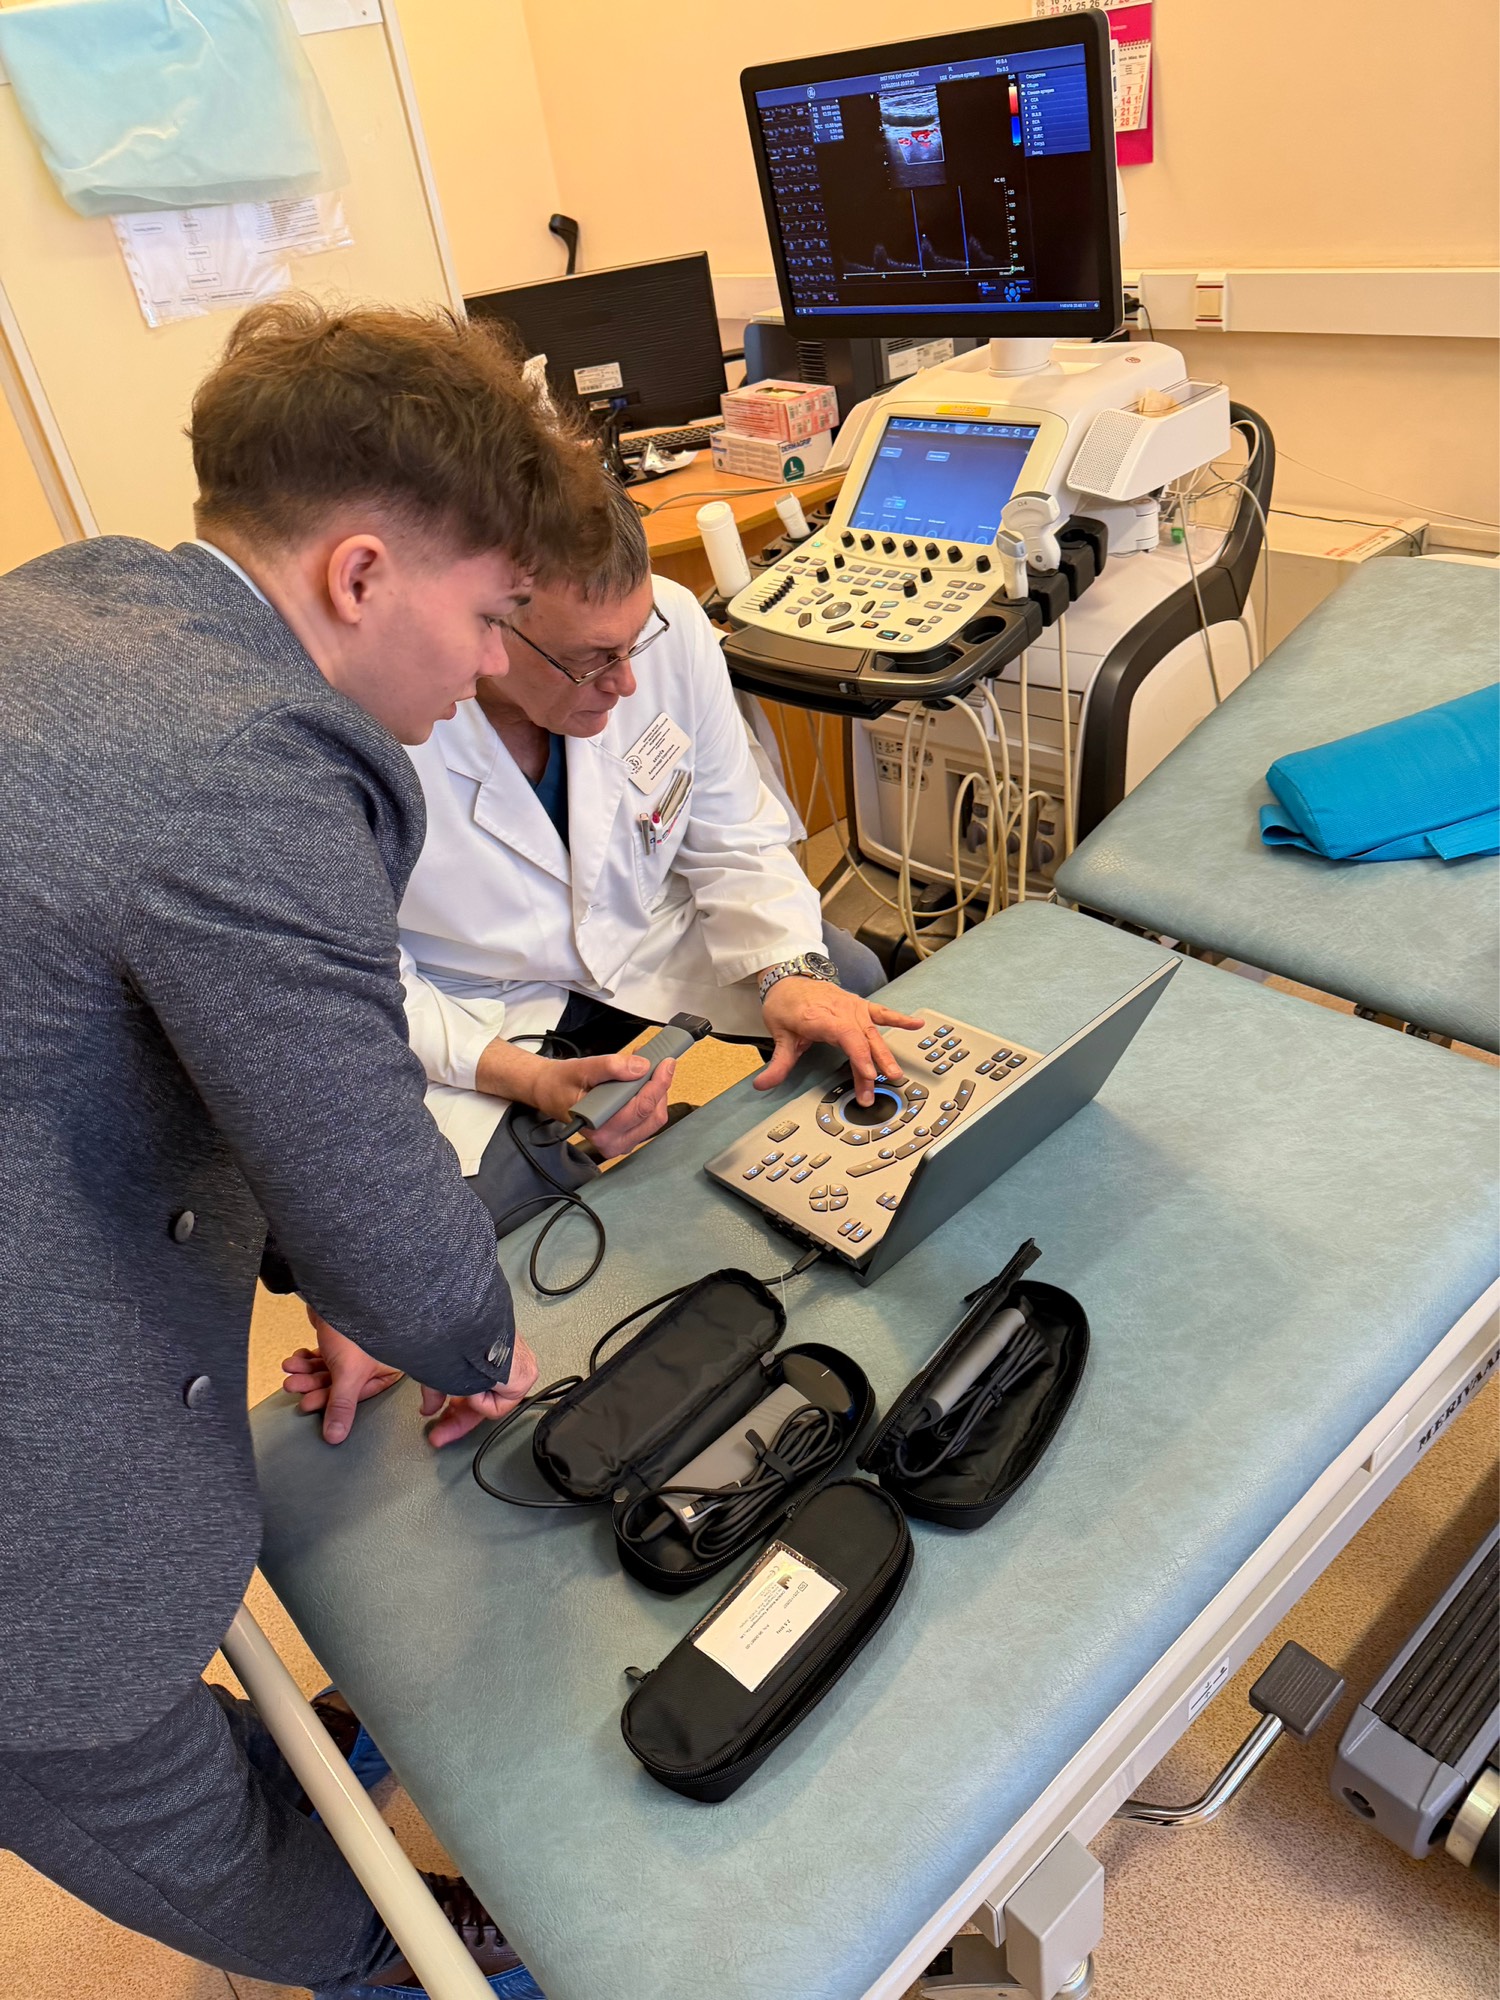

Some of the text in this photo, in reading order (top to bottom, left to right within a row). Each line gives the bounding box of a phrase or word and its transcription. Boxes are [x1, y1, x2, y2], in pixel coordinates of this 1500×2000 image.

[1050, 7, 1060, 16] 23
[1063, 4, 1072, 13] 24
[1076, 2, 1086, 10] 25
[1126, 86, 1132, 95] 7
[1122, 97, 1131, 106] 14
[1121, 108, 1130, 116] 21
[1120, 118, 1130, 126] 28
[782, 438, 812, 453] DERMAGRIP
[790, 460, 796, 472] L
